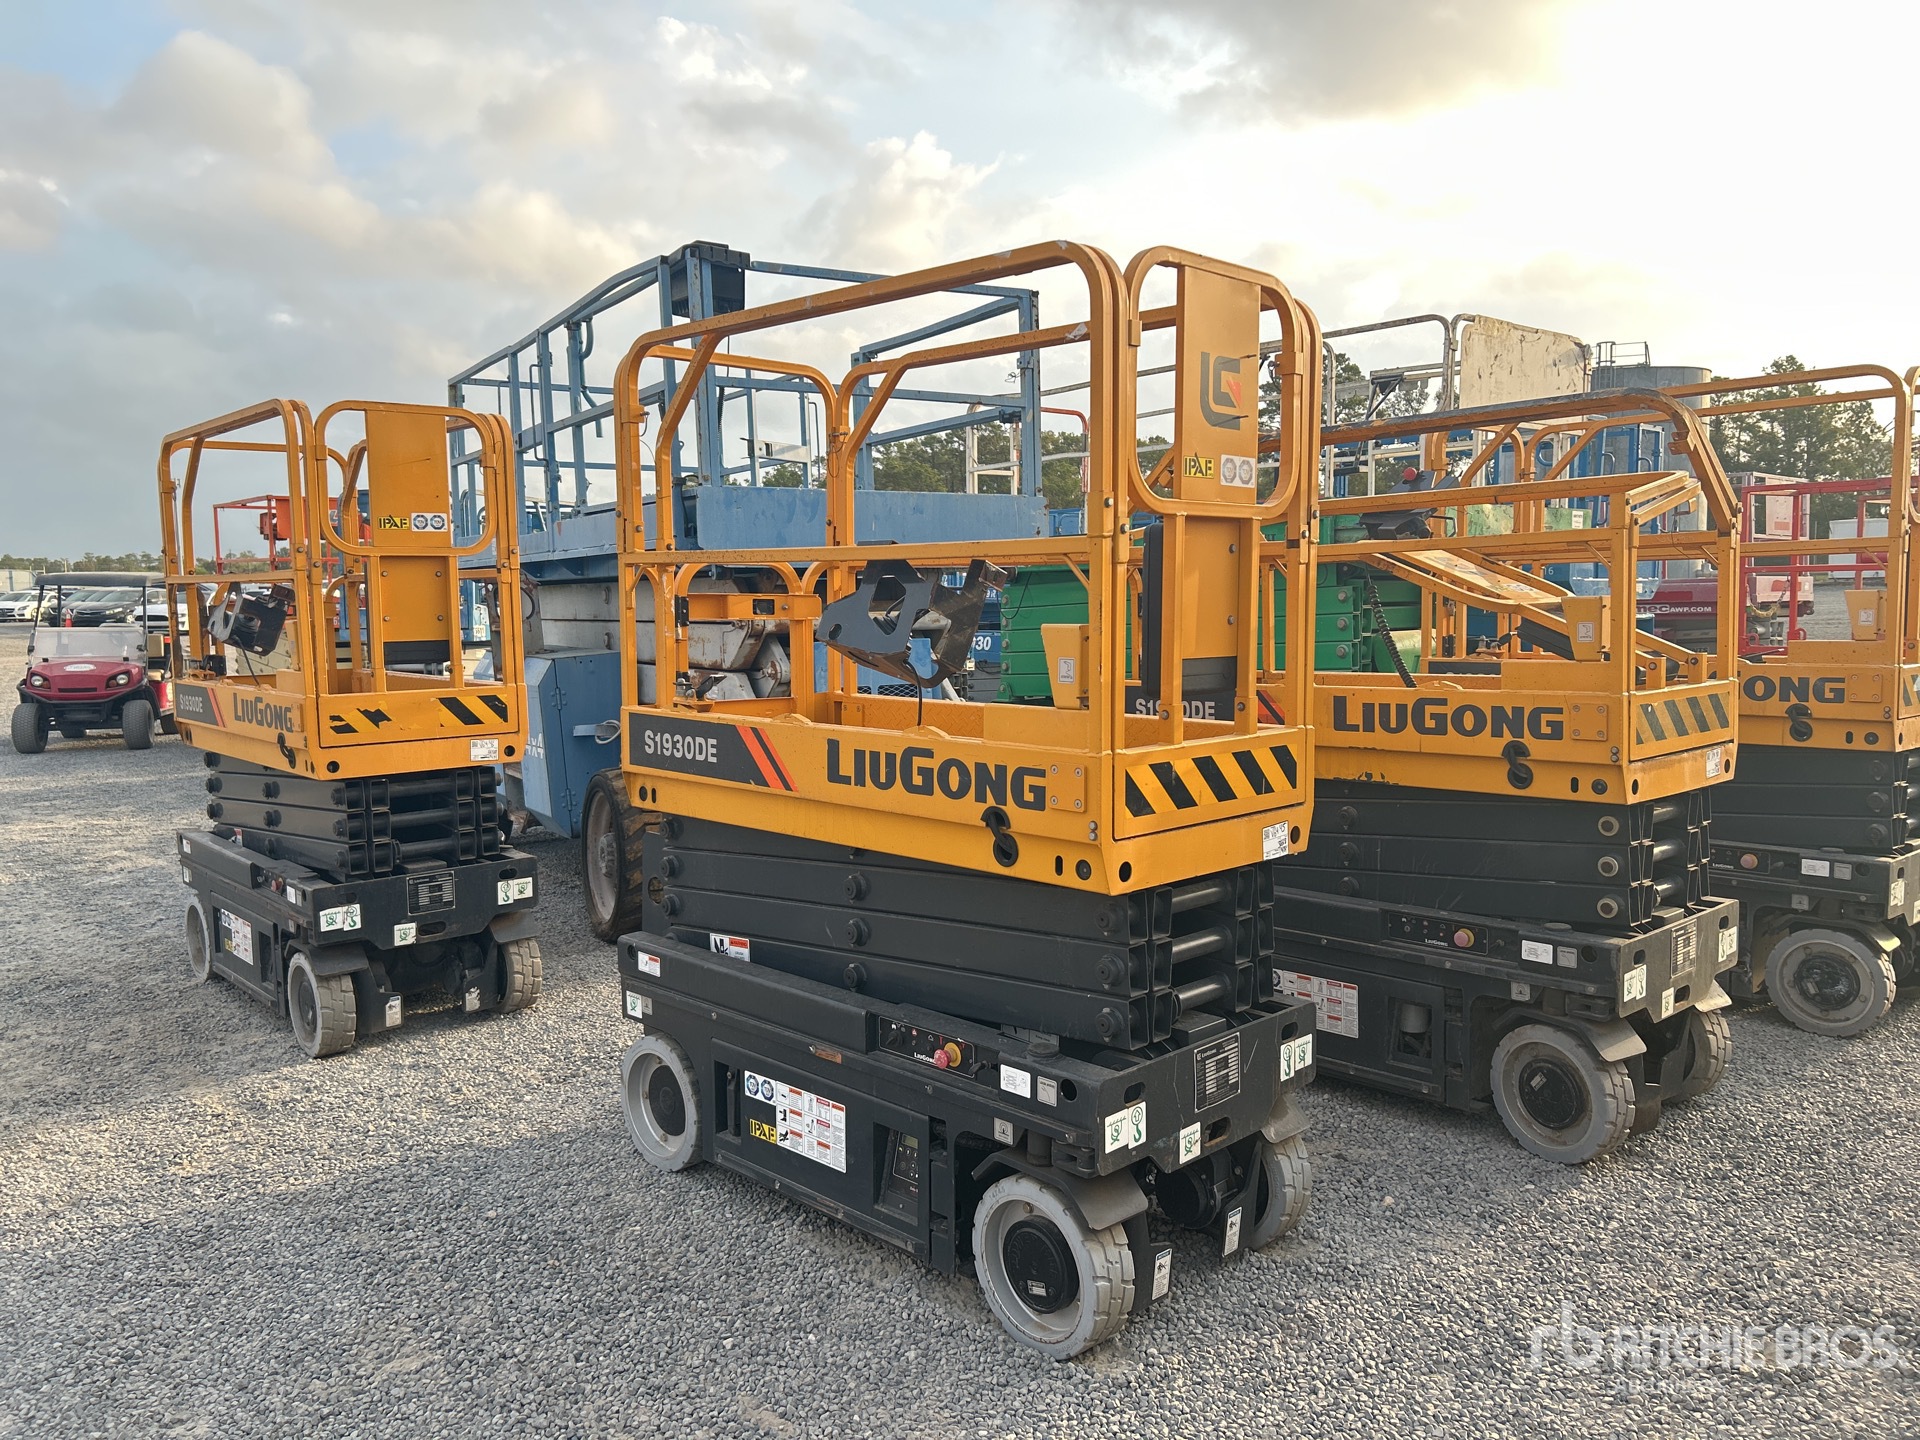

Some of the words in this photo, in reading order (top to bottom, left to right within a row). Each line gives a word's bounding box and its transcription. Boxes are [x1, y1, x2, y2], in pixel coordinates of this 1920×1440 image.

[1185, 452, 1212, 477] IPAF
[378, 515, 408, 529] IPAF
[180, 693, 203, 713] S1930DE
[1737, 674, 1846, 704] ONG
[233, 692, 294, 733] LIUGONG
[1333, 695, 1564, 741] LIUGONG
[644, 729, 718, 763] S1930DE
[826, 738, 1047, 812] LIUGONG
